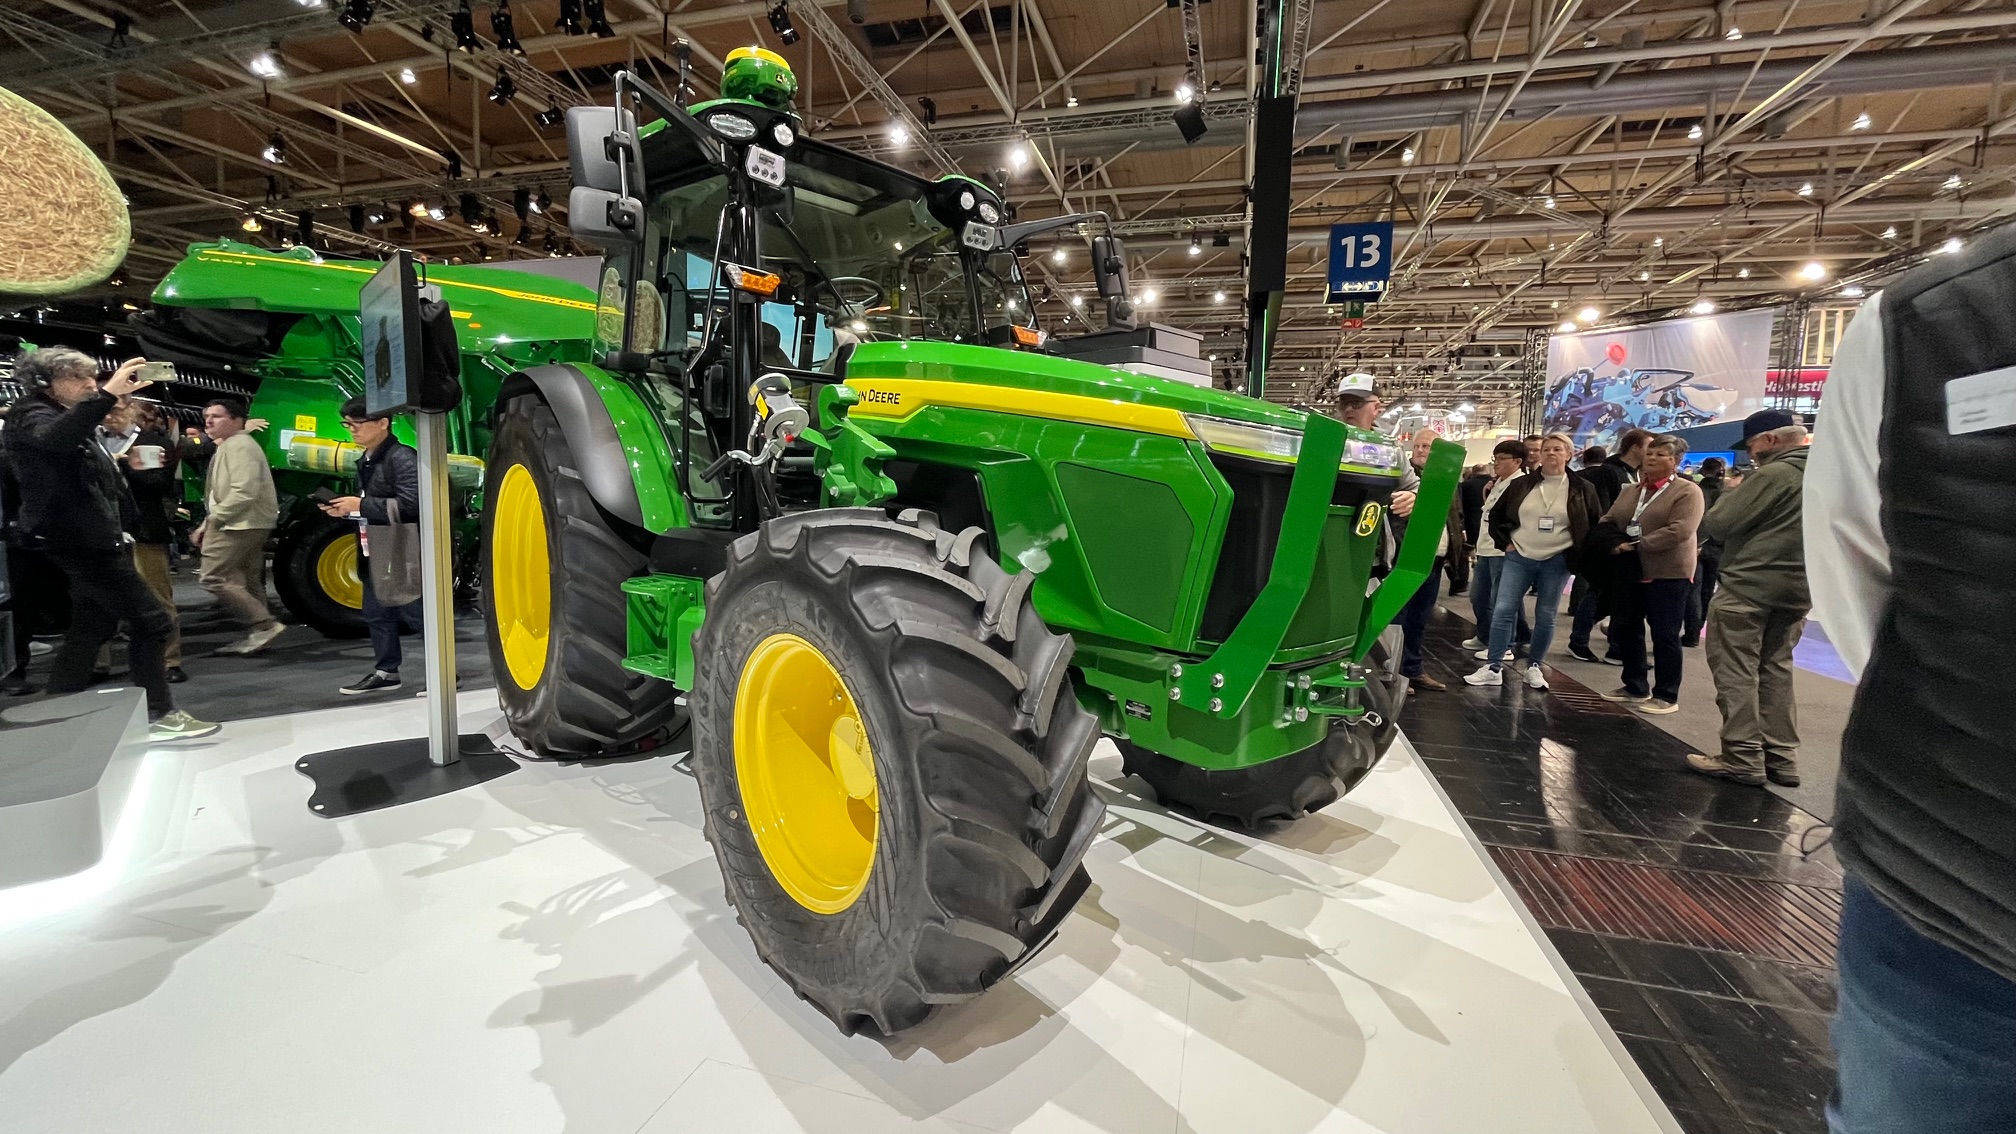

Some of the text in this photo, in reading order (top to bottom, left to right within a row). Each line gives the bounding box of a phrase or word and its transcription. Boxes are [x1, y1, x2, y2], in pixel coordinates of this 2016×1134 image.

[1341, 234, 1381, 268] 13
[1765, 380, 1823, 392] Harvesti
[869, 389, 901, 404] DEERE
